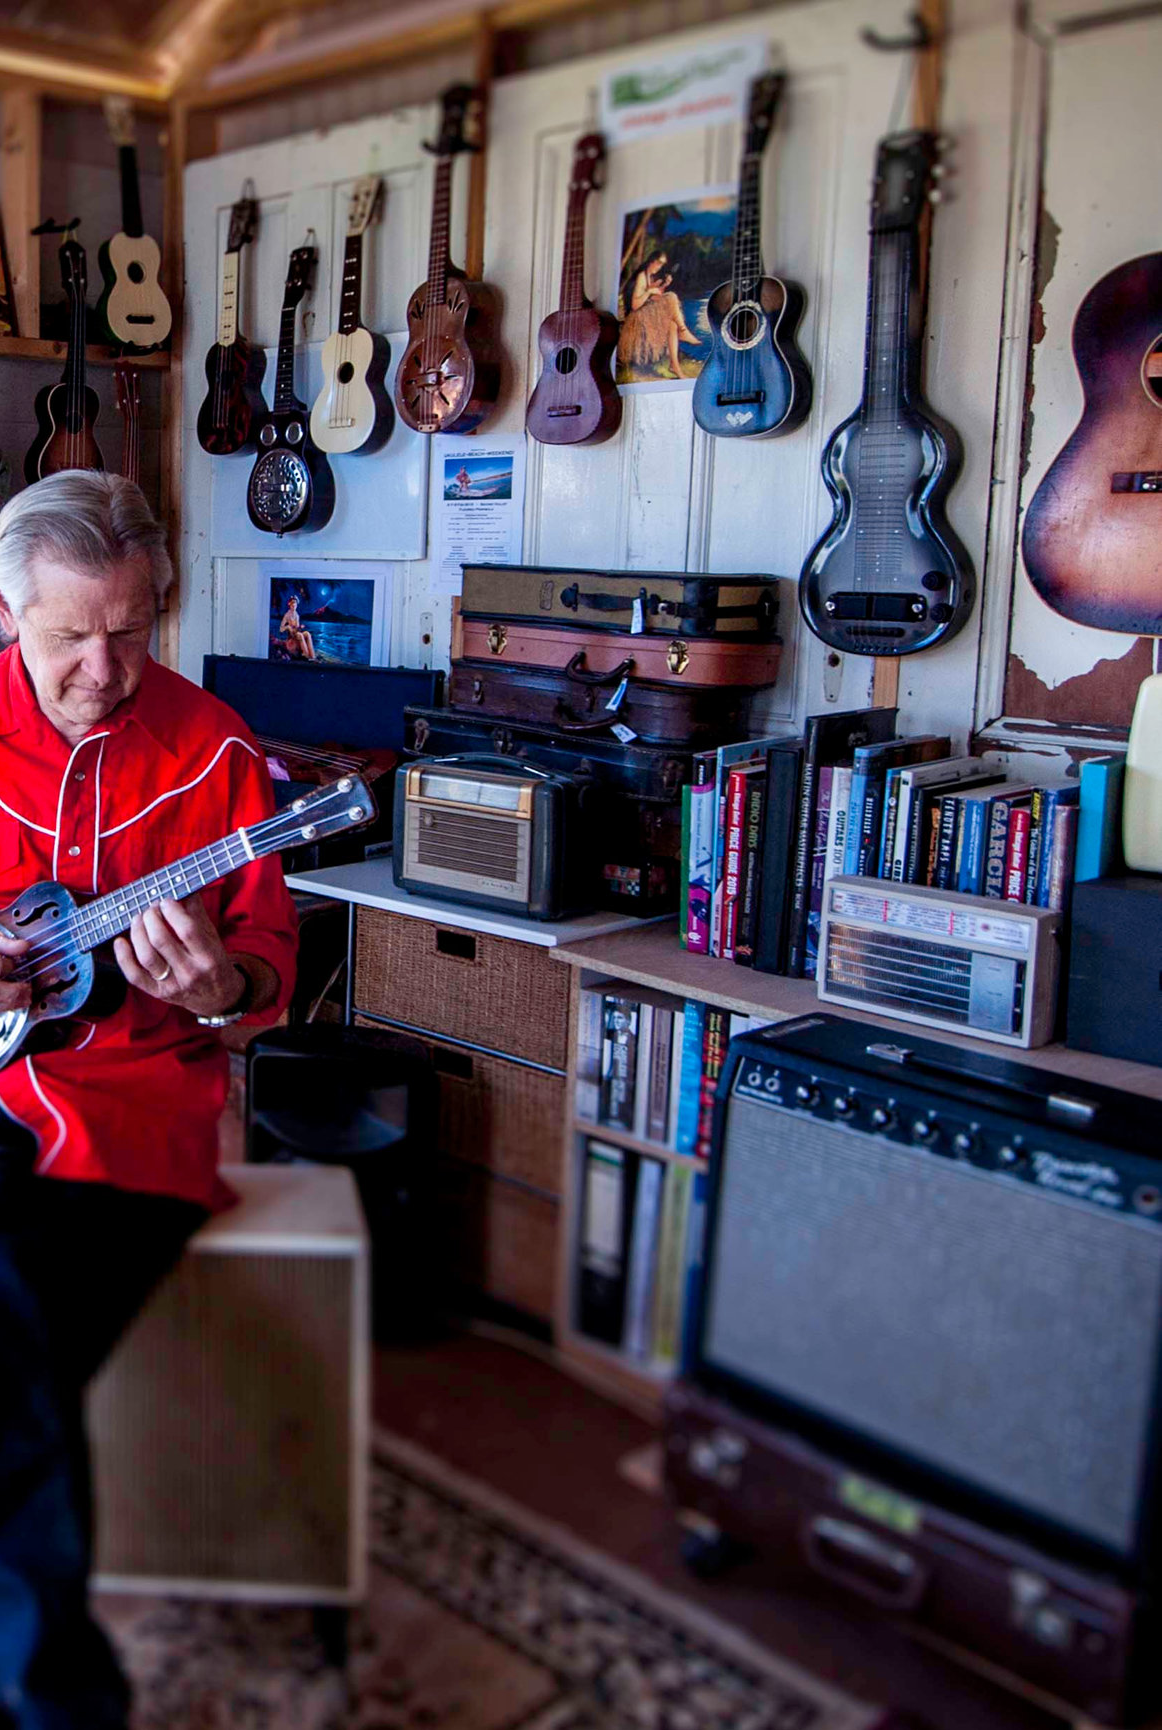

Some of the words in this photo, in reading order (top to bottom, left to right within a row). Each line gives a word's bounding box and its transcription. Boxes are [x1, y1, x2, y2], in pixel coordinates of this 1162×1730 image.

[802, 763, 813, 796] MARTIN
[750, 791, 761, 823] RADIO
[799, 797, 811, 828] GUITAR
[942, 800, 955, 834] FENDER
[729, 826, 740, 850] PRICE
[748, 825, 760, 849] DAYS
[939, 838, 951, 862] AMPS
[985, 802, 1008, 900] GARCIA
[728, 851, 739, 873] GUIDE
[795, 829, 808, 887] MASTERPIECES
[833, 848, 844, 864] 100
[1008, 870, 1021, 896] PRICE
